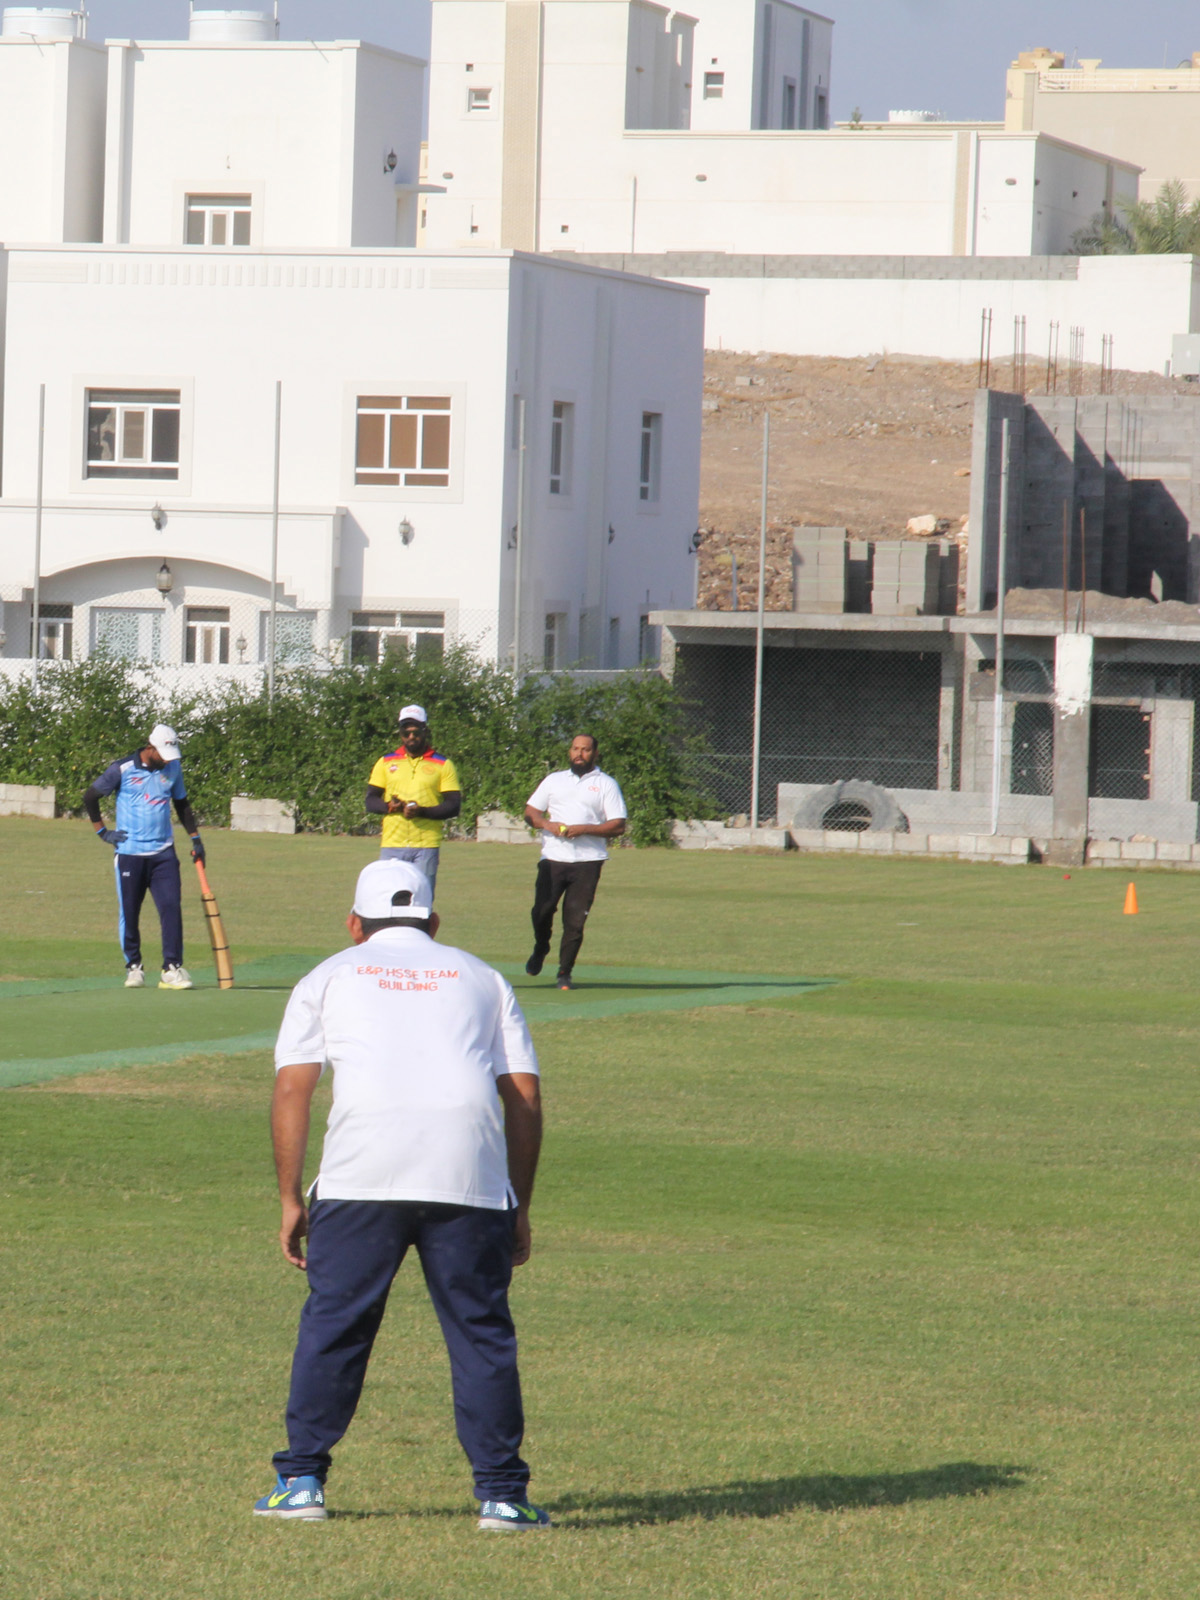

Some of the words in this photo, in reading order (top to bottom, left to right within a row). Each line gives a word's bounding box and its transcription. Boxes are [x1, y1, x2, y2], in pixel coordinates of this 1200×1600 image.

[357, 966, 383, 975] E&P
[386, 968, 419, 980] HSSE
[424, 970, 459, 979] TEAM
[379, 979, 438, 991] BUILDING
